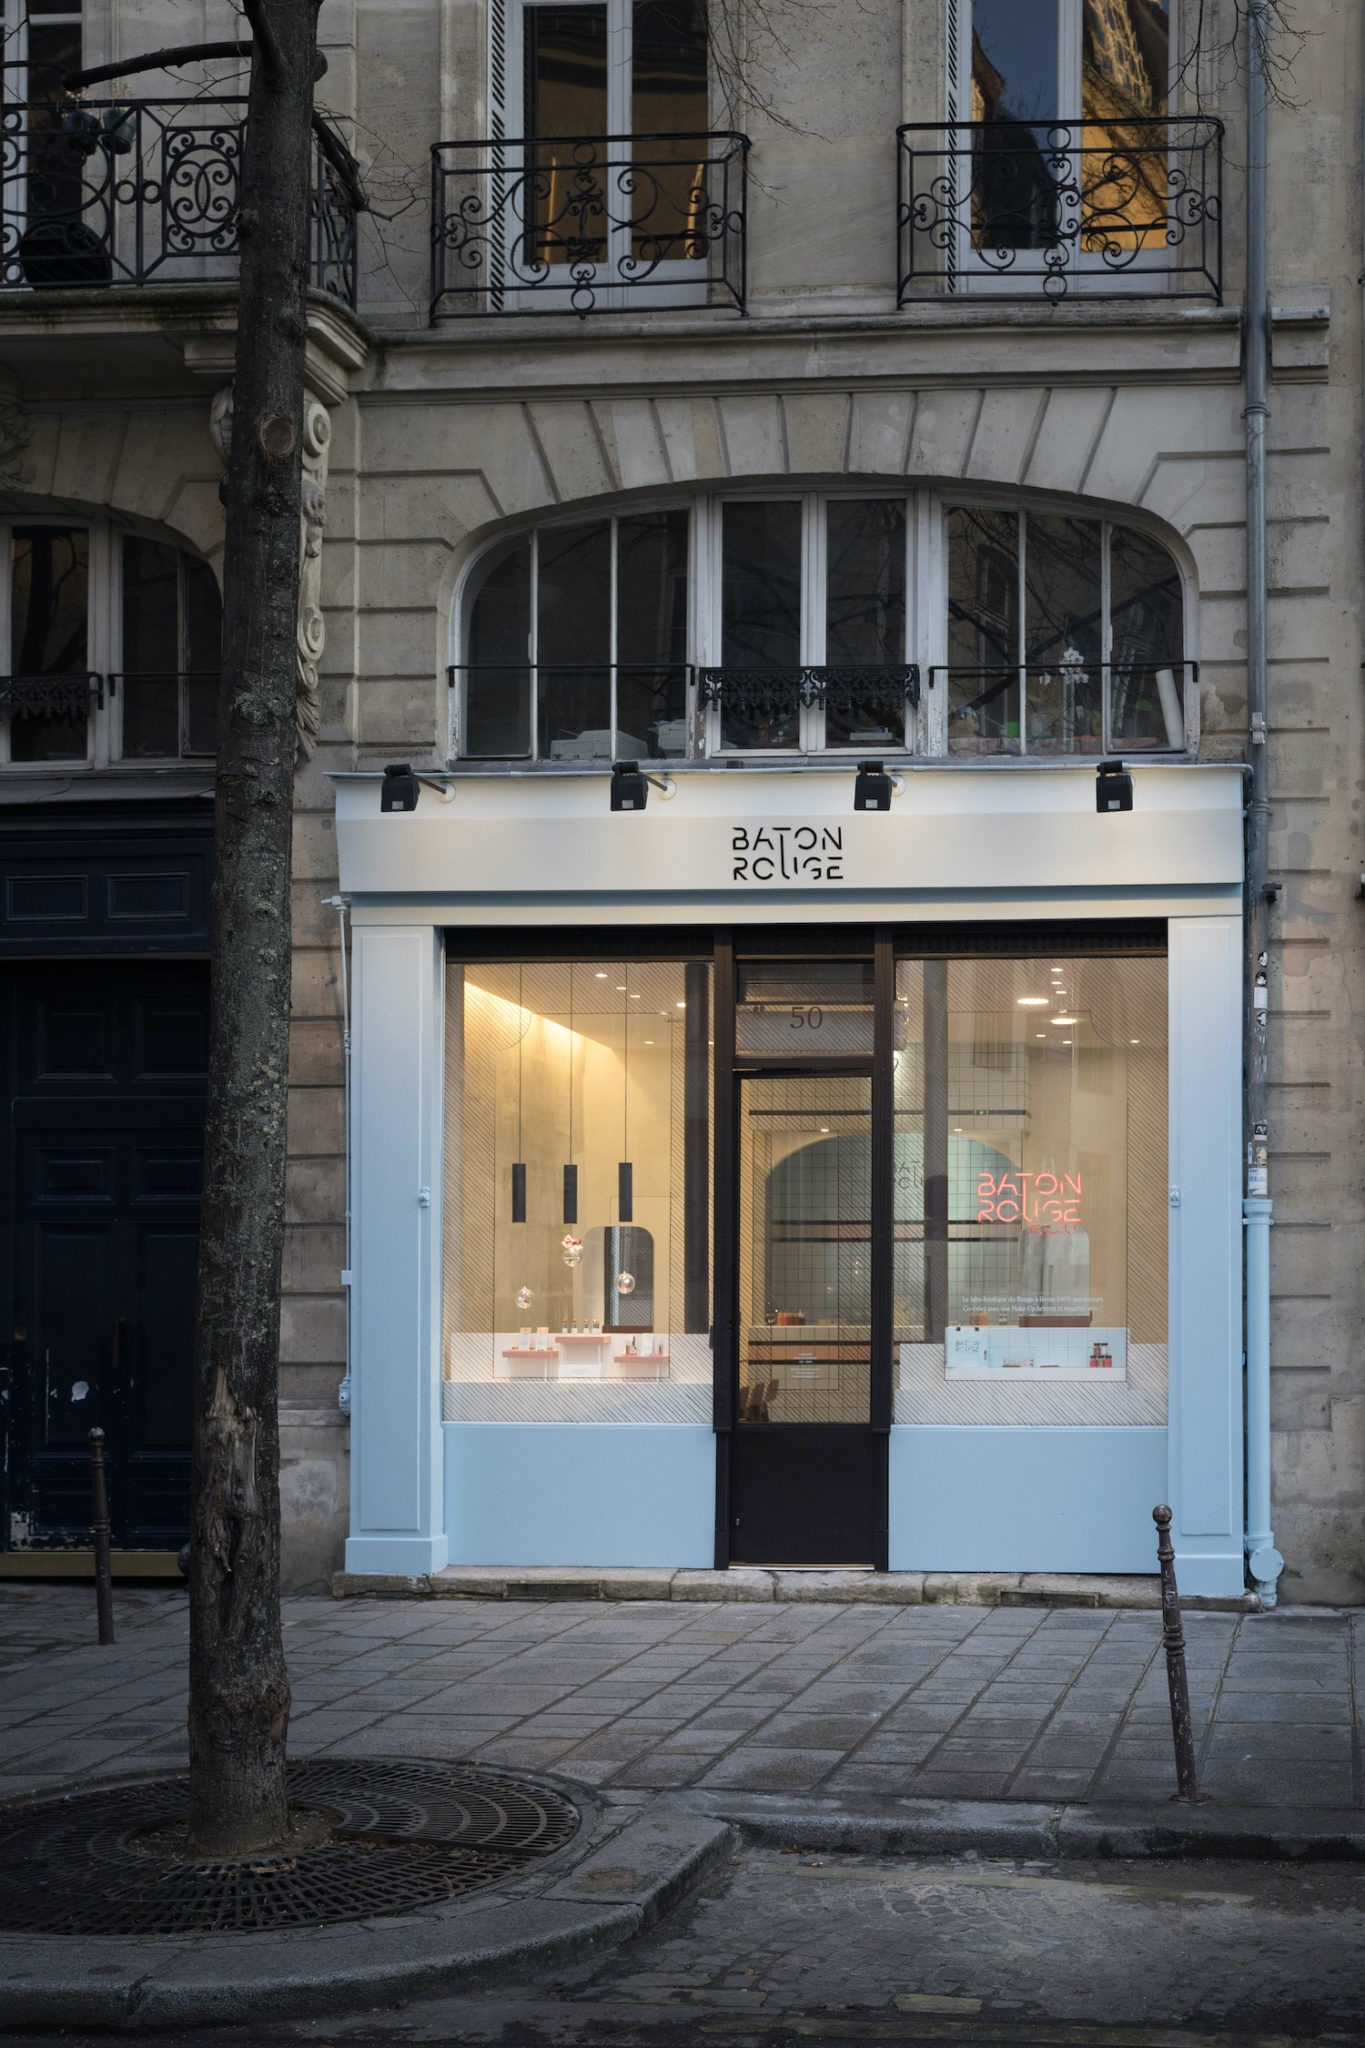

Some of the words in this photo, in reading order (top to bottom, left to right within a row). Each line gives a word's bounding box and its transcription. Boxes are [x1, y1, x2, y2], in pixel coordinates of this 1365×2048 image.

[732, 826, 843, 851] BATON
[733, 856, 844, 880] ROUGE
[789, 1006, 823, 1030] 50
[977, 1172, 1082, 1196] BATON
[977, 1199, 1082, 1222] ROUGE
